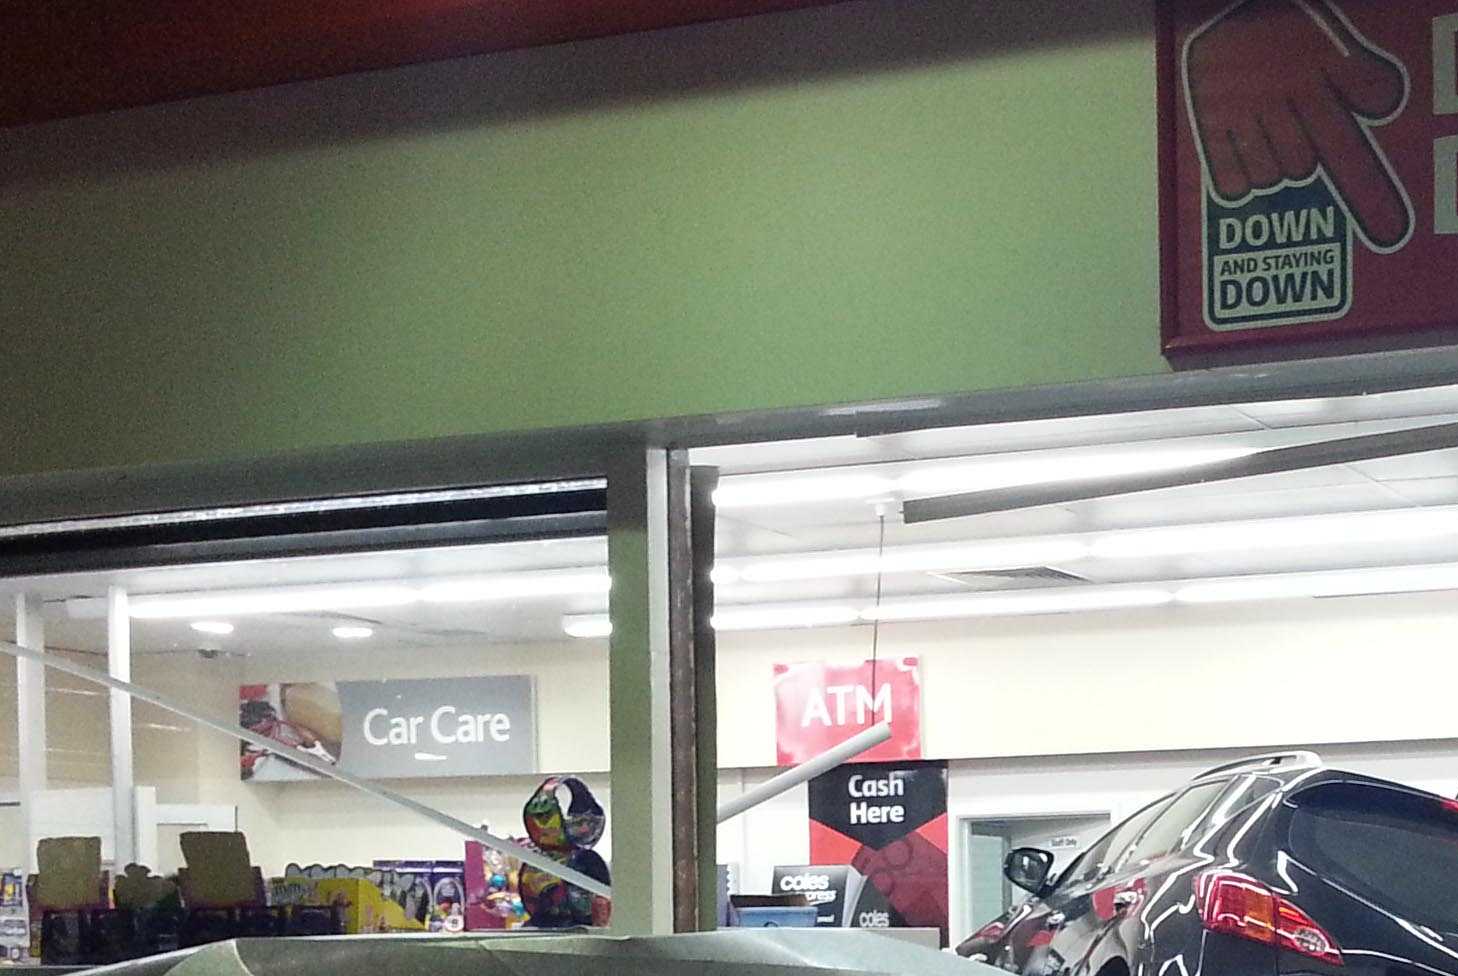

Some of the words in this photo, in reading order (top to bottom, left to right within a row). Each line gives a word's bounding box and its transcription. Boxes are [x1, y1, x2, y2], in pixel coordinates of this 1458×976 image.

[1218, 205, 1335, 250] DOWN
[1219, 256, 1260, 276] AND
[1262, 249, 1335, 273] STAYING
[1218, 268, 1335, 310] DOWN
[801, 683, 892, 728] ATM
[363, 708, 424, 745] Car
[431, 705, 511, 743] Care
[848, 774, 904, 798] Cash
[850, 802, 904, 825] Here
[780, 873, 829, 891] coles
[860, 909, 889, 928] coles
